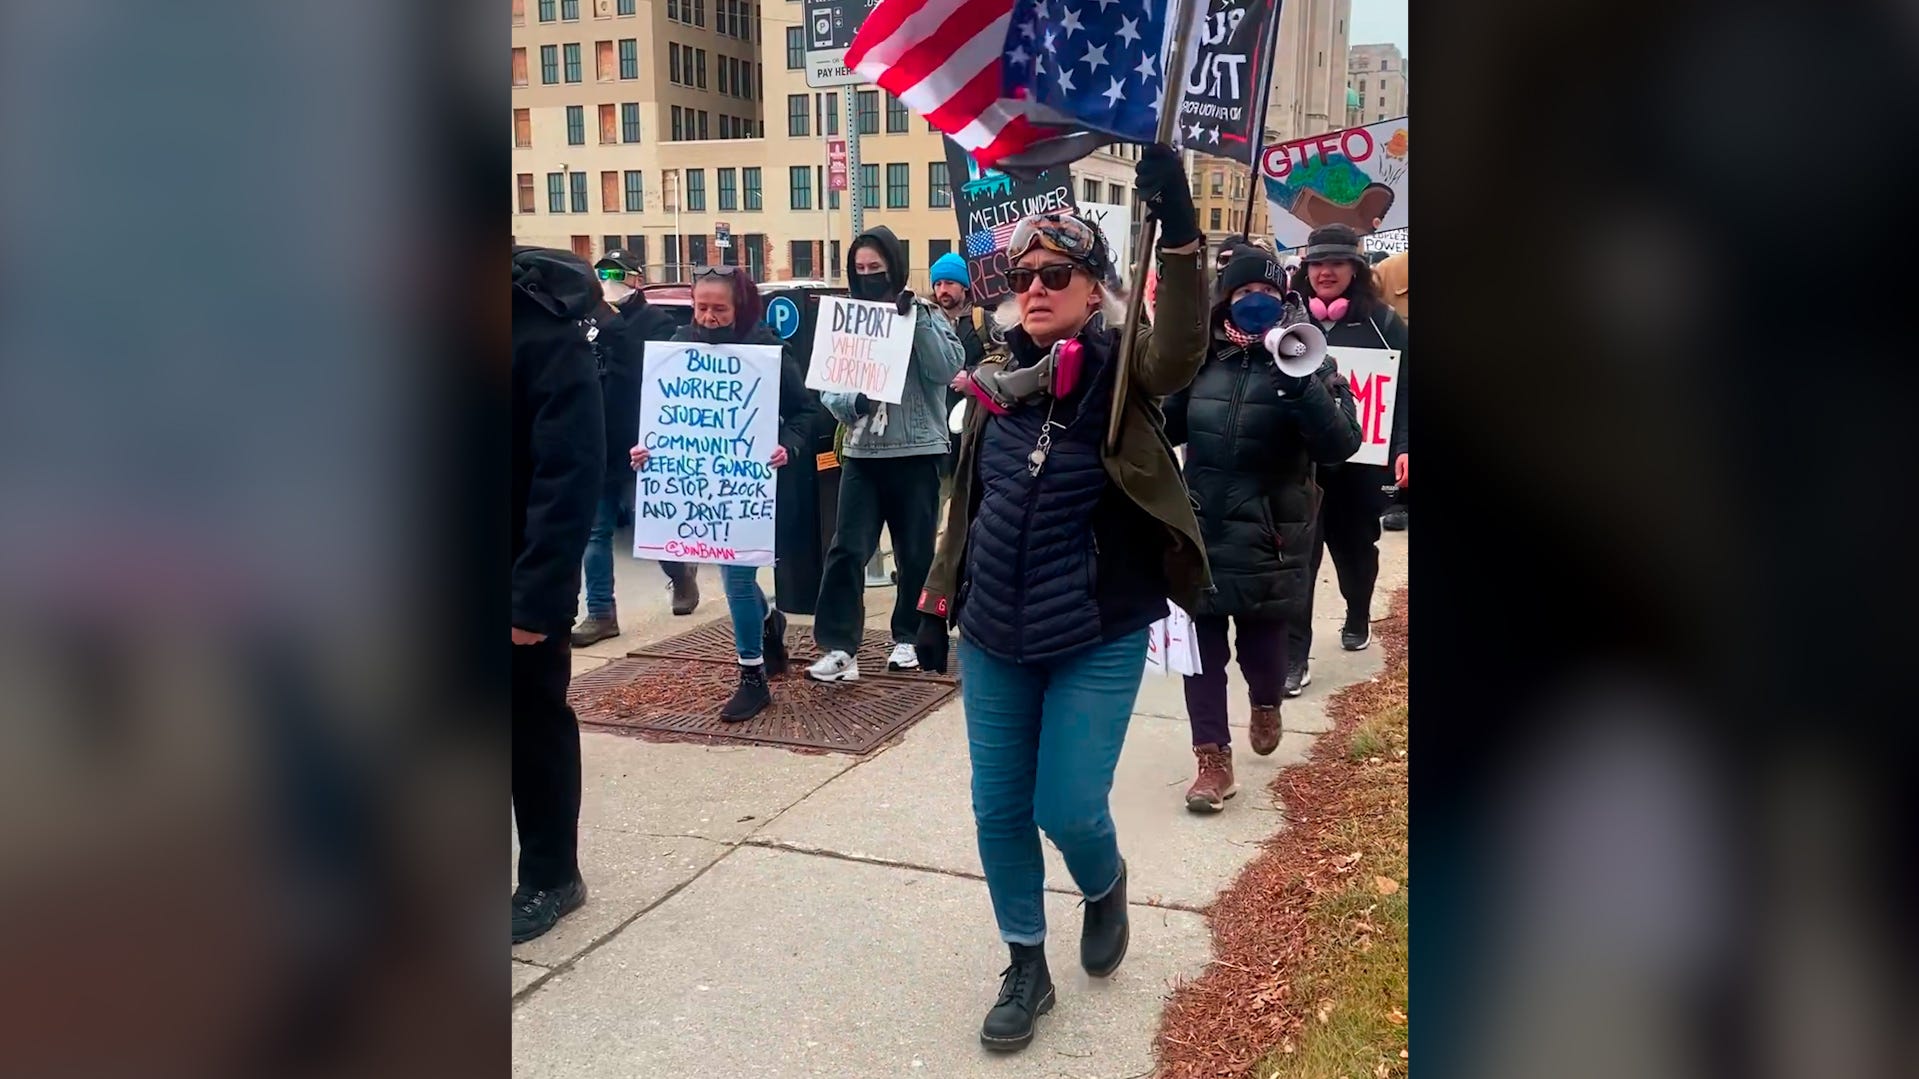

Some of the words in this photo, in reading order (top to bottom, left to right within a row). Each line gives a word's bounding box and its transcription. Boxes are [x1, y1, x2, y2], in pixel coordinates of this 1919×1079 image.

[817, 68, 833, 78] PAY
[1262, 127, 1374, 178] GTFO
[968, 200, 1020, 235] MELTS
[1022, 186, 1070, 216] UNDER
[775, 304, 790, 332] P
[832, 301, 898, 339] DEPORT
[685, 348, 741, 375] BUILD
[832, 335, 877, 361] WHITE
[820, 355, 891, 393] SUPREMACY
[657, 376, 762, 410] WORKER/
[644, 431, 756, 458] COMMUNITY
[641, 454, 707, 477] DEFENSE
[712, 455, 773, 480] GUARDS
[641, 477, 661, 496] TO
[664, 476, 713, 501] STOP,
[718, 479, 768, 499] BLOCK
[642, 500, 677, 519] AND
[684, 500, 734, 521] DRIVE
[677, 522, 730, 543] OUT!
